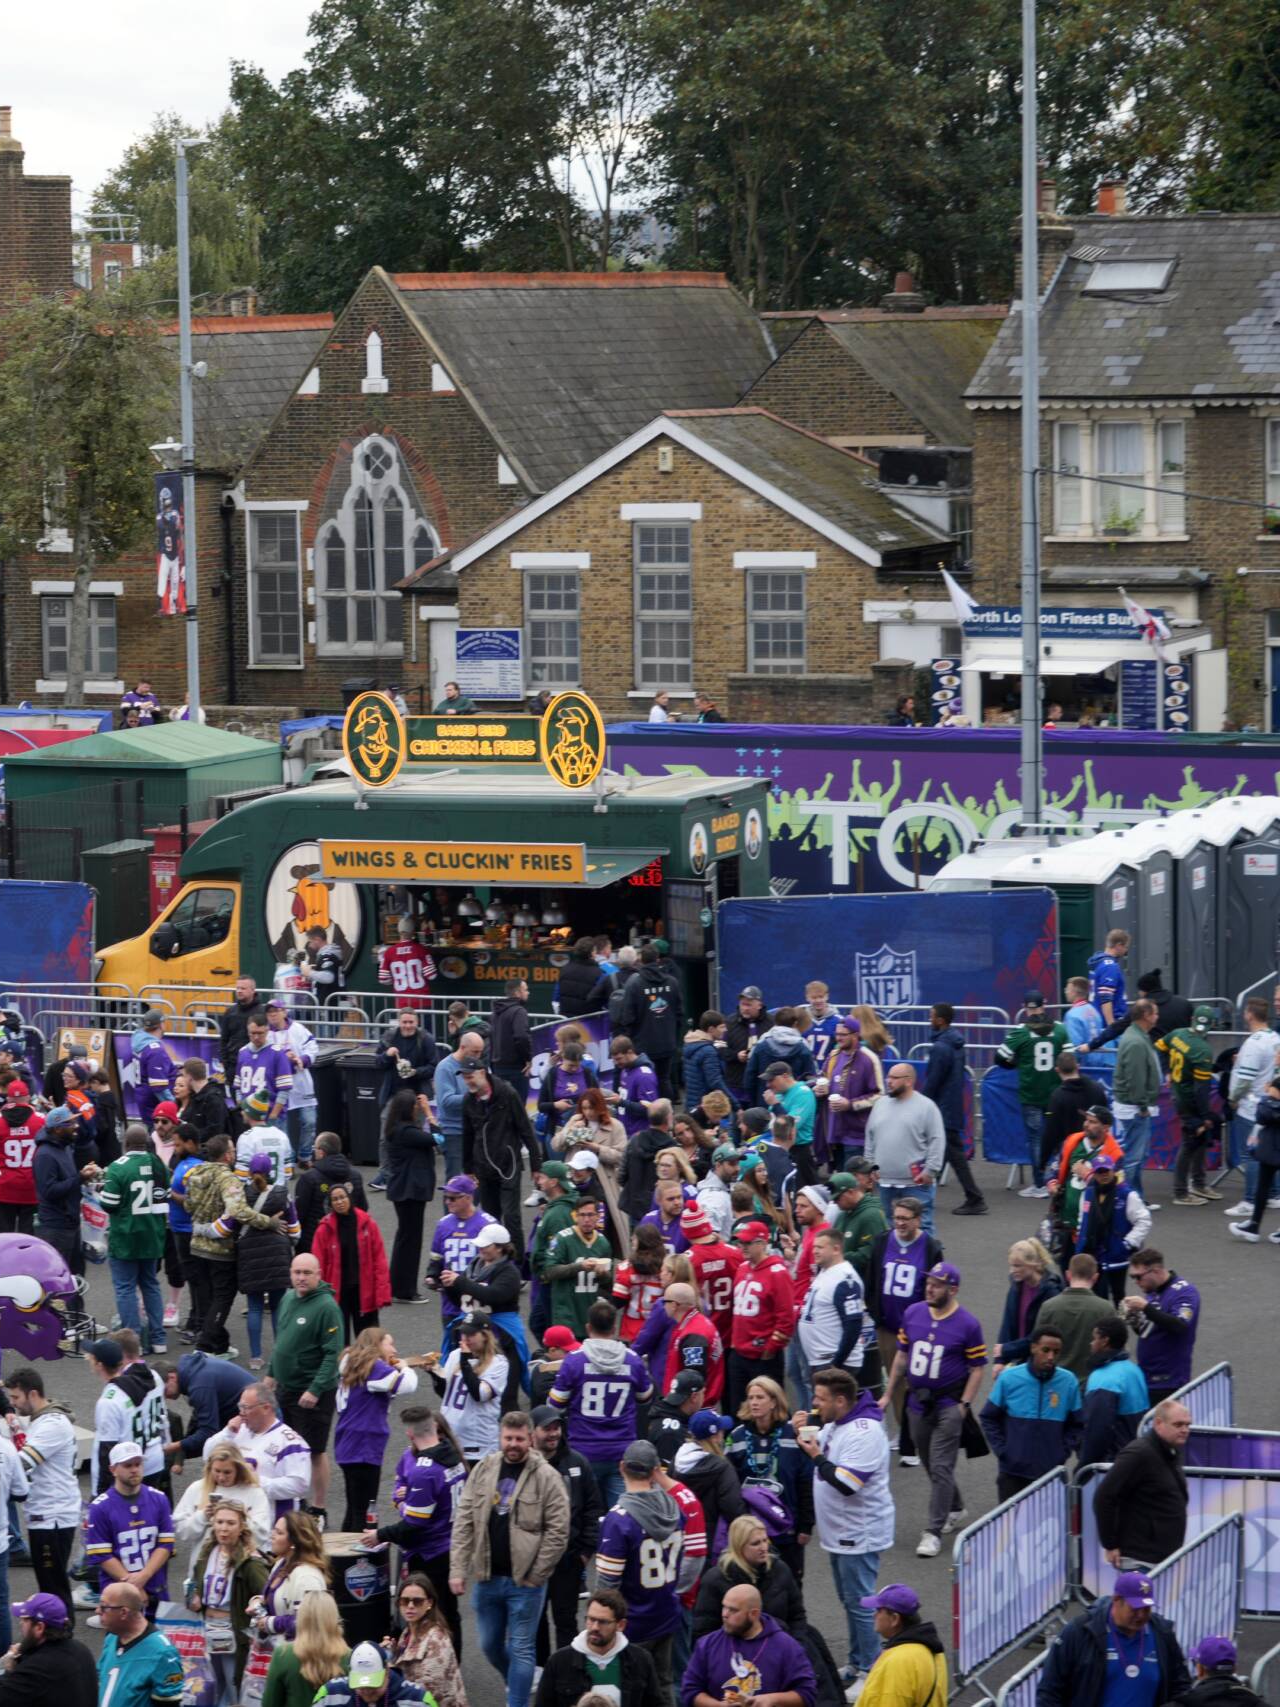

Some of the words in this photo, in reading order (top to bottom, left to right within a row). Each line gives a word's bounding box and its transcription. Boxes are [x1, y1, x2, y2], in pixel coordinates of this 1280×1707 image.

[964, 611, 1000, 624] orth
[1004, 612, 1057, 624] Loon
[1060, 612, 1104, 626] Finest
[437, 725, 477, 737] BAKED
[478, 725, 506, 737] BIRD
[410, 740, 479, 756] CHICKEN
[480, 740, 493, 755] &
[493, 740, 536, 756] FRIES
[711, 812, 741, 833] BAKED
[716, 835, 738, 854] BIRD
[331, 850, 396, 868] WINGS
[402, 852, 419, 868] &
[424, 851, 514, 870] CLUCKIN'
[521, 853, 573, 871] FRIES
[390, 959, 423, 991] 80
[474, 966, 528, 981] BAKED
[533, 967, 561, 982] BIR
[863, 978, 912, 1006] NFL
[1034, 1041, 1054, 1071] 8
[240, 1066, 267, 1094] 84
[4, 1139, 37, 1168] 97
[884, 1262, 917, 1297] 19
[702, 1277, 732, 1311] 12
[910, 1340, 945, 1379] 61
[580, 1381, 631, 1417] 87
[662, 1417, 681, 1430] 90
[118, 1526, 159, 1572] 22
[639, 1530, 684, 1589] 87
